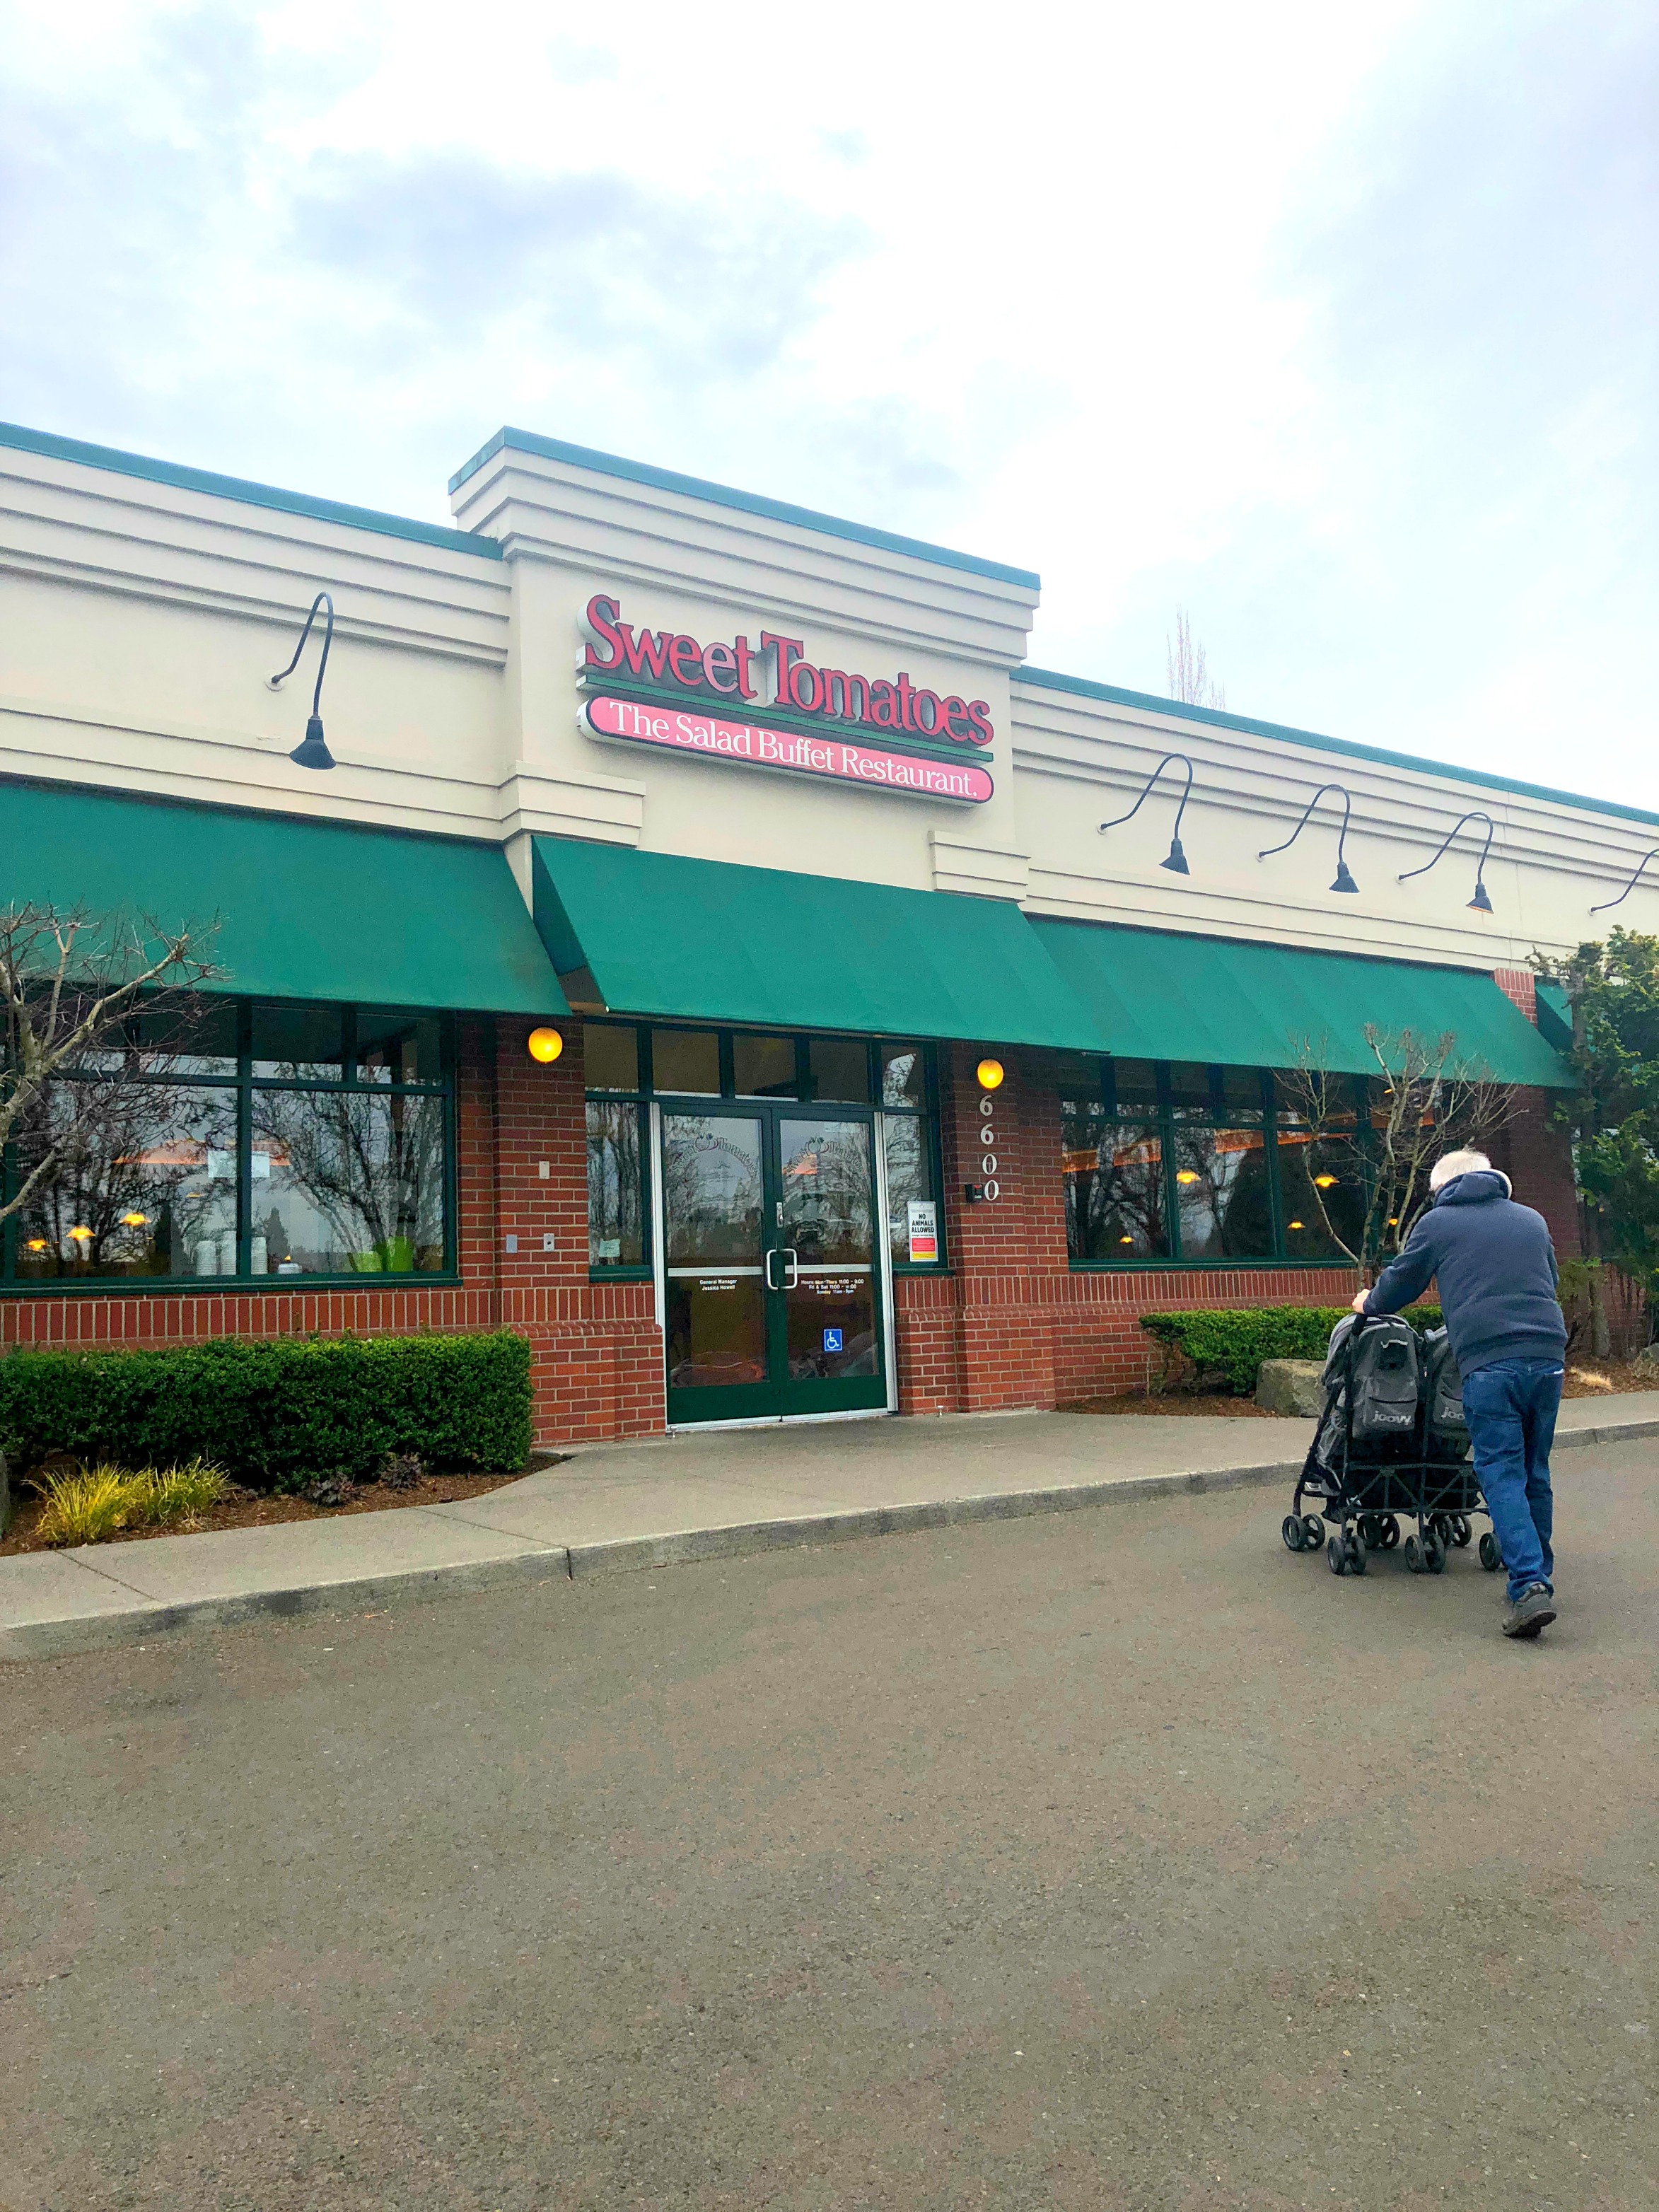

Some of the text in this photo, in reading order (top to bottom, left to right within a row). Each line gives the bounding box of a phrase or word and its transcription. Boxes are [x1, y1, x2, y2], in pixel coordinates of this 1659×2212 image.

[586, 594, 994, 745] Sweet Tomatoes
[610, 701, 670, 740] The
[675, 713, 752, 755] Salad
[758, 731, 835, 772] Buffet
[979, 1095, 999, 1201] 6600
[1372, 1410, 1412, 1426] joovy
[1440, 1407, 1466, 1421] joo
